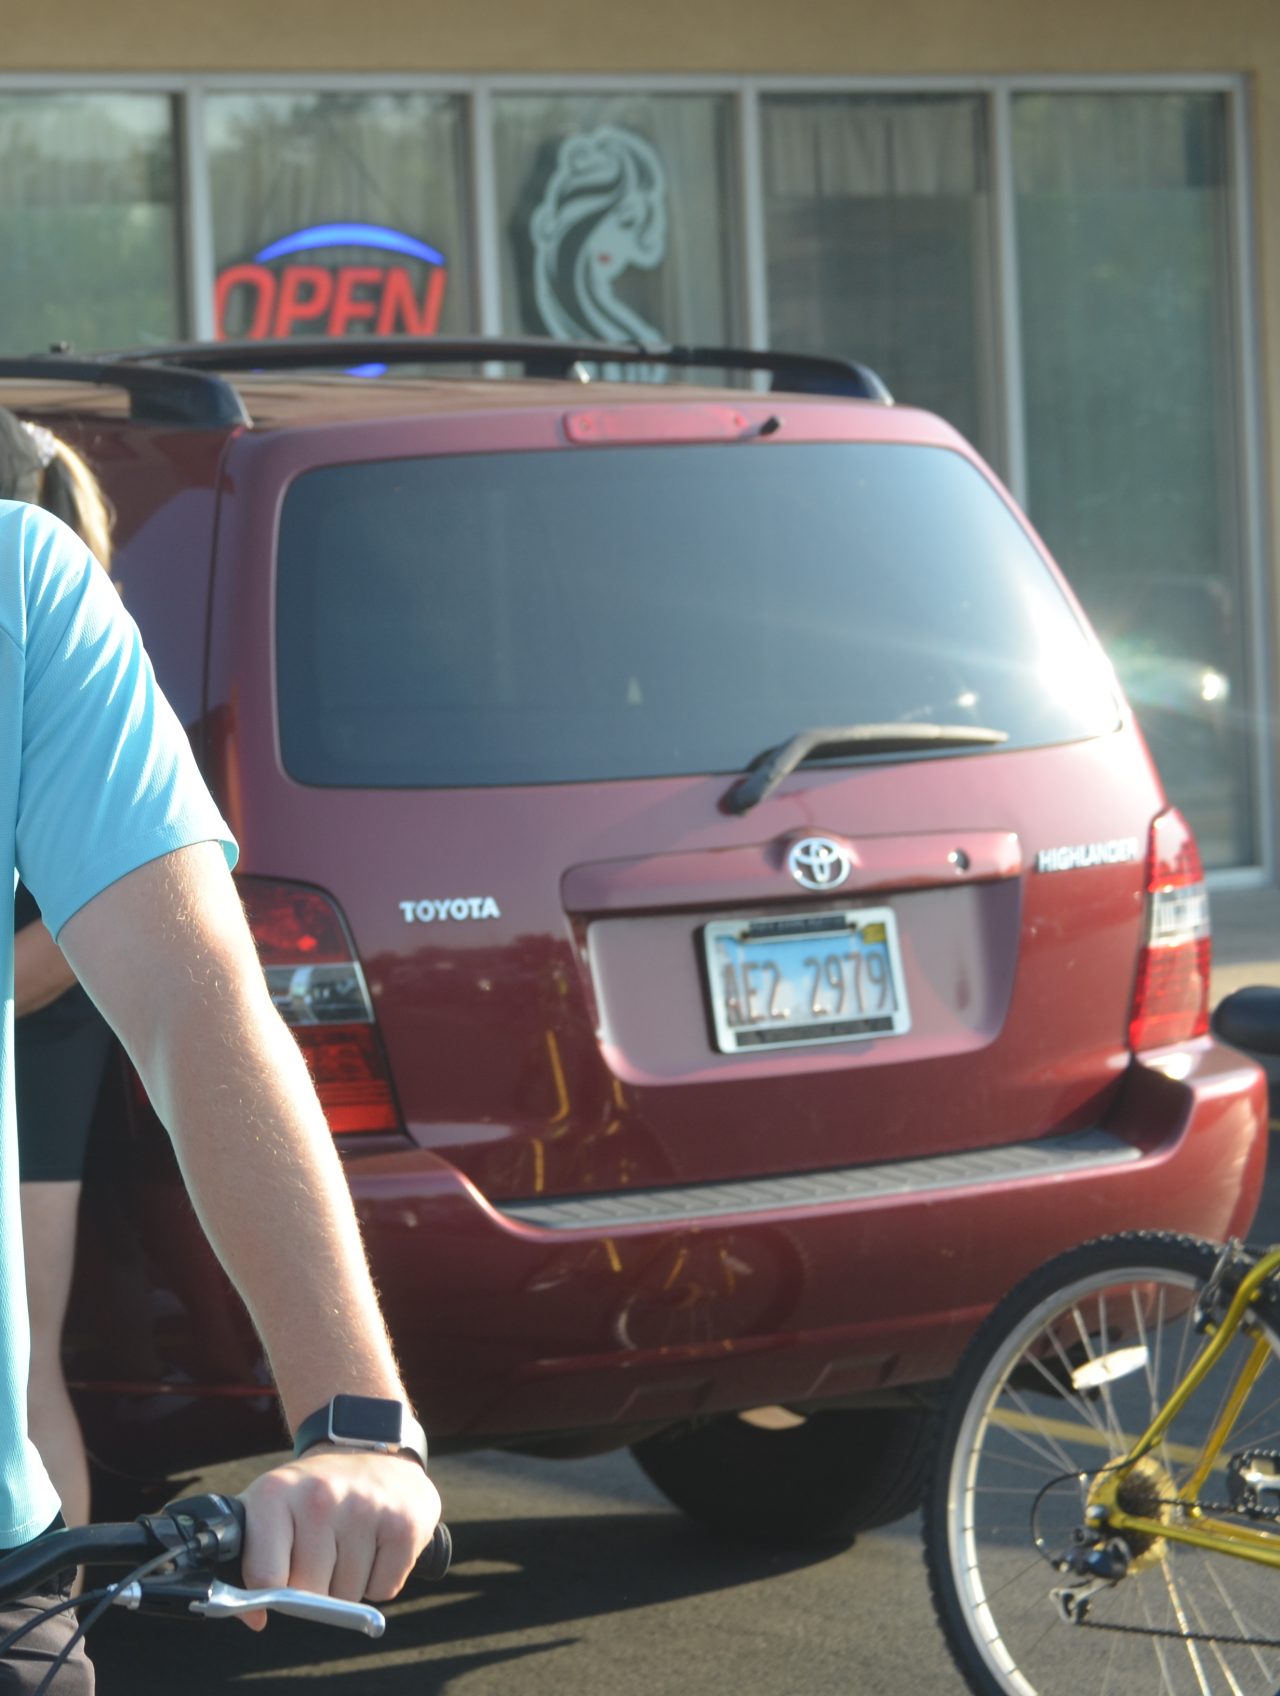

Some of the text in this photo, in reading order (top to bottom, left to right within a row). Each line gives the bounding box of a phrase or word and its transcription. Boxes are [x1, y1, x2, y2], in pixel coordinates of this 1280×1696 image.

[213, 263, 448, 341] OPEN
[399, 896, 501, 923] TOYOTA
[803, 951, 889, 1016] 2979
